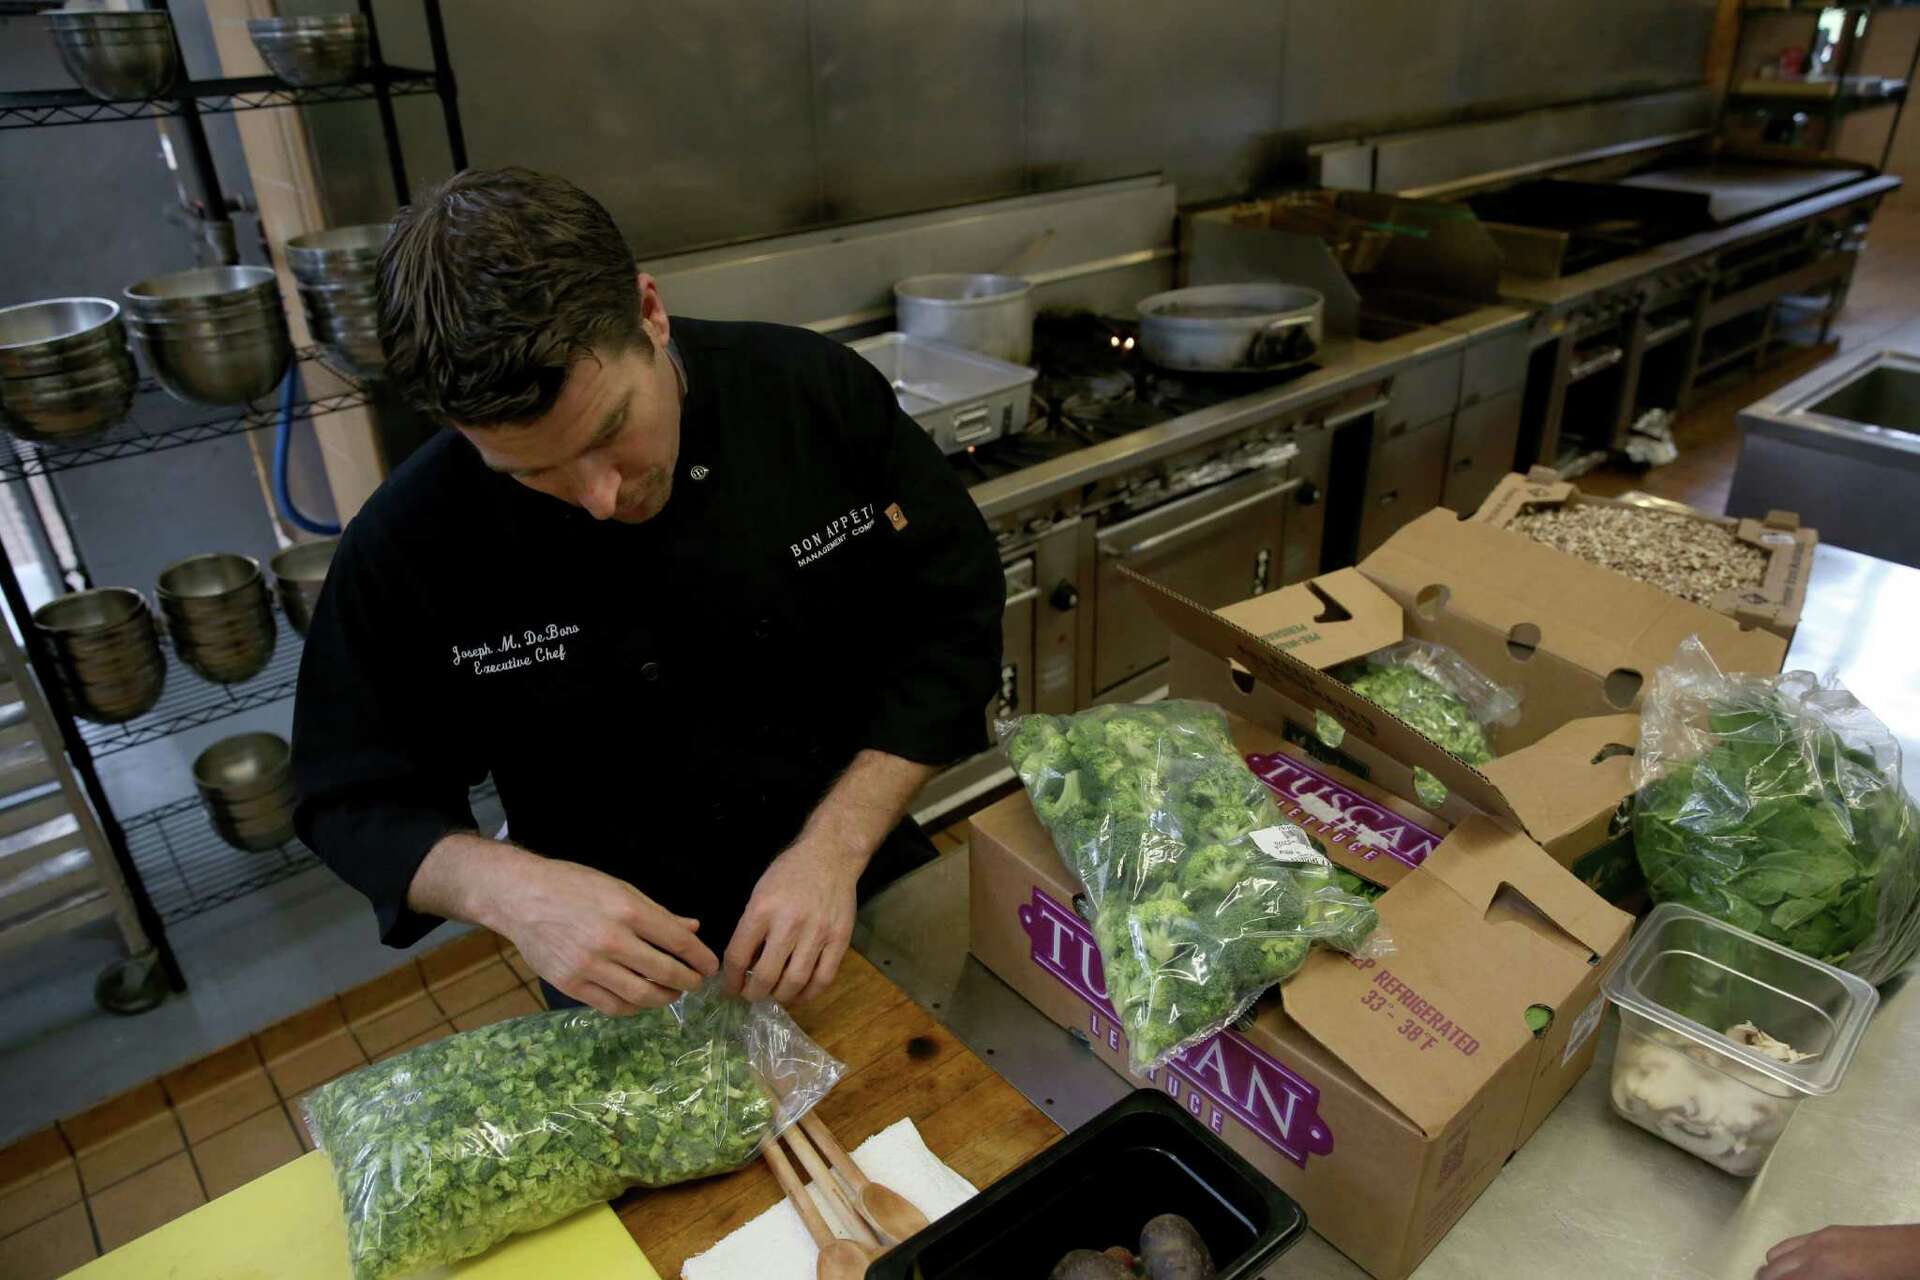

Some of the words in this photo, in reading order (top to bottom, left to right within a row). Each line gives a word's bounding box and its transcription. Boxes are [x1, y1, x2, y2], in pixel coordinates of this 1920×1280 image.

[789, 532, 822, 557] BON
[797, 532, 847, 568] MANAGEMENT
[452, 642, 493, 666] Joseph
[473, 656, 533, 675] Executive
[535, 643, 567, 663] Chef
[1041, 908, 1302, 1141] TUAN
[1372, 969, 1481, 1057] REFRIGERATED
[1090, 1011, 1224, 1135] LEUCE
